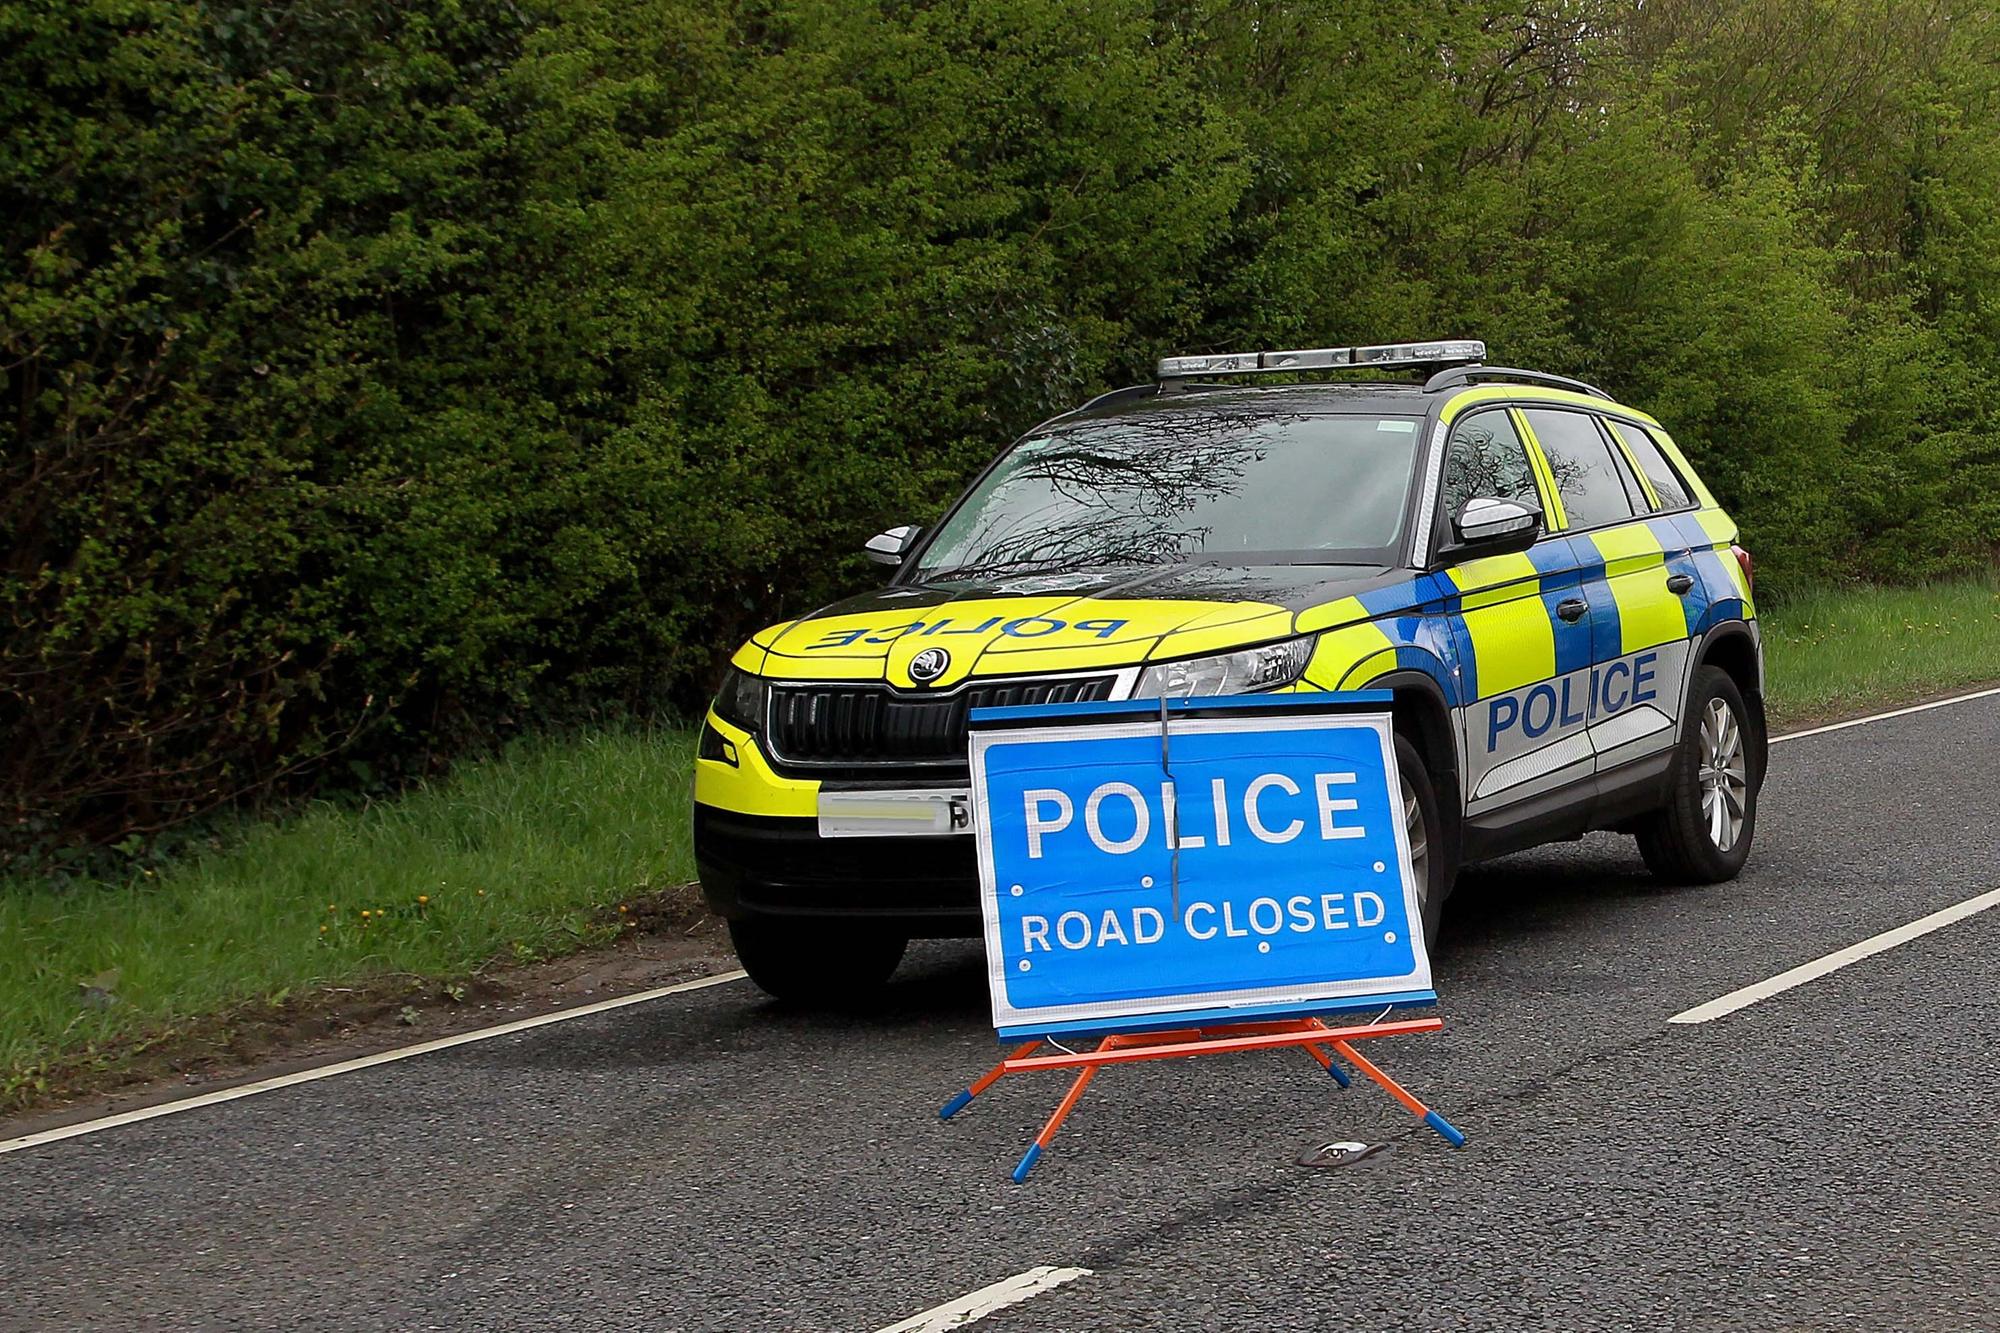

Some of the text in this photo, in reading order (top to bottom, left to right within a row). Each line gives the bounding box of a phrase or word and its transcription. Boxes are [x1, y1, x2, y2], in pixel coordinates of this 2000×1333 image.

[1488, 653, 1657, 753] POLICE
[1023, 772, 1366, 859] POLICE
[1021, 891, 1385, 953] ROAD CLOSED
